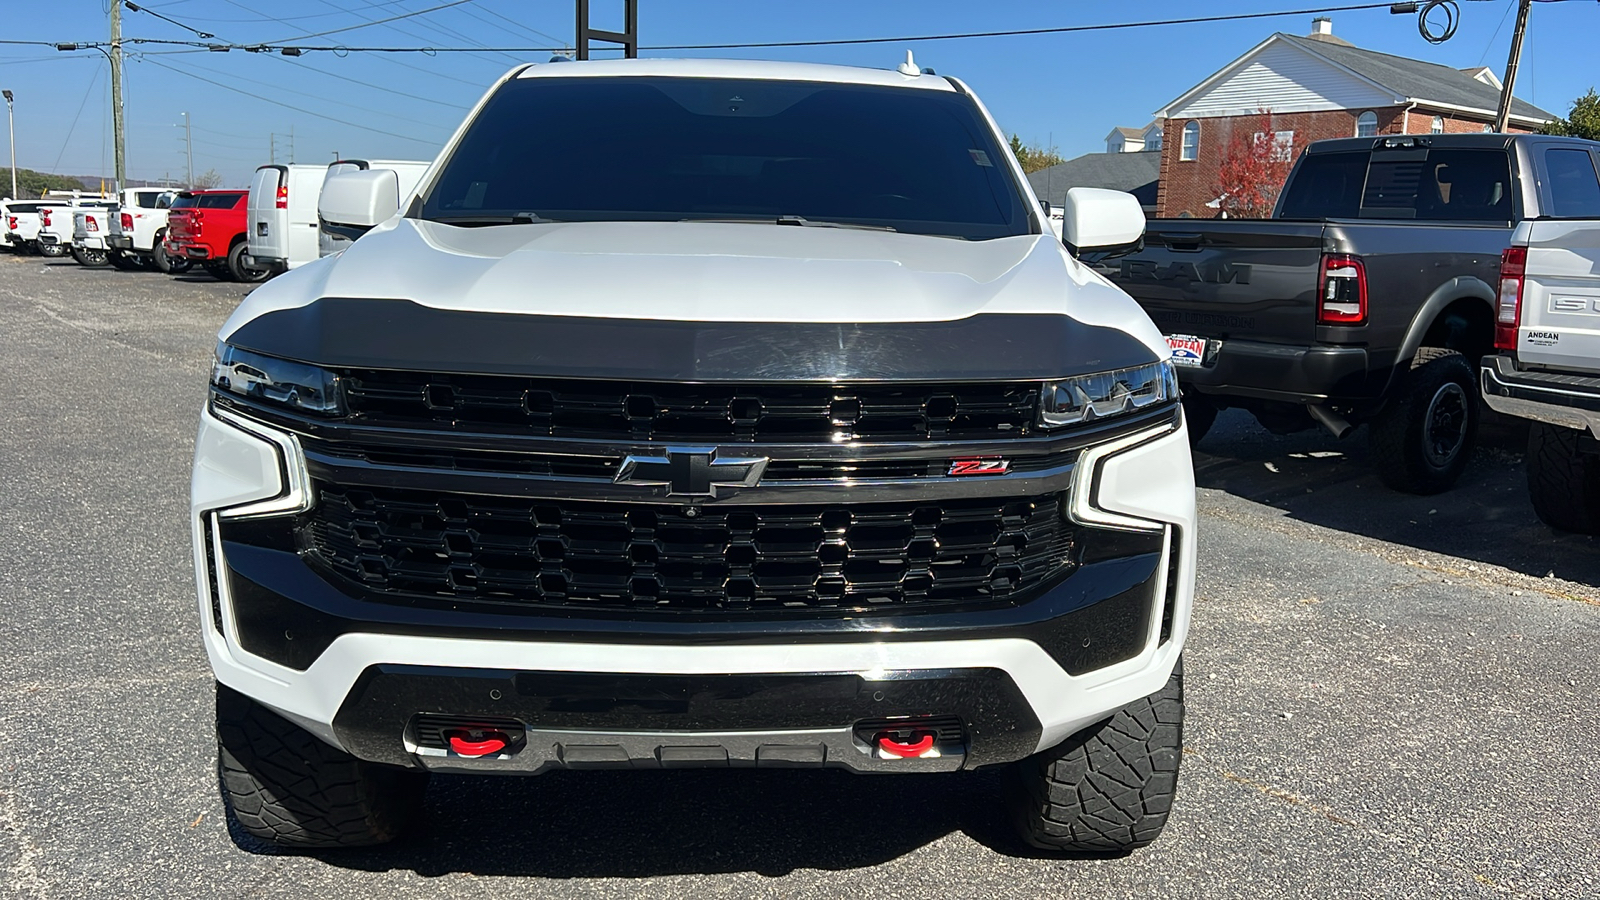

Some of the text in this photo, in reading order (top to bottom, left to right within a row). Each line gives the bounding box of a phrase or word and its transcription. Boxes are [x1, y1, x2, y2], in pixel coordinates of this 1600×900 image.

[1119, 259, 1253, 284] RAM
[1554, 298, 1600, 313] S
[1527, 331, 1559, 340] ANDEAN
[948, 460, 1010, 475] Z71
